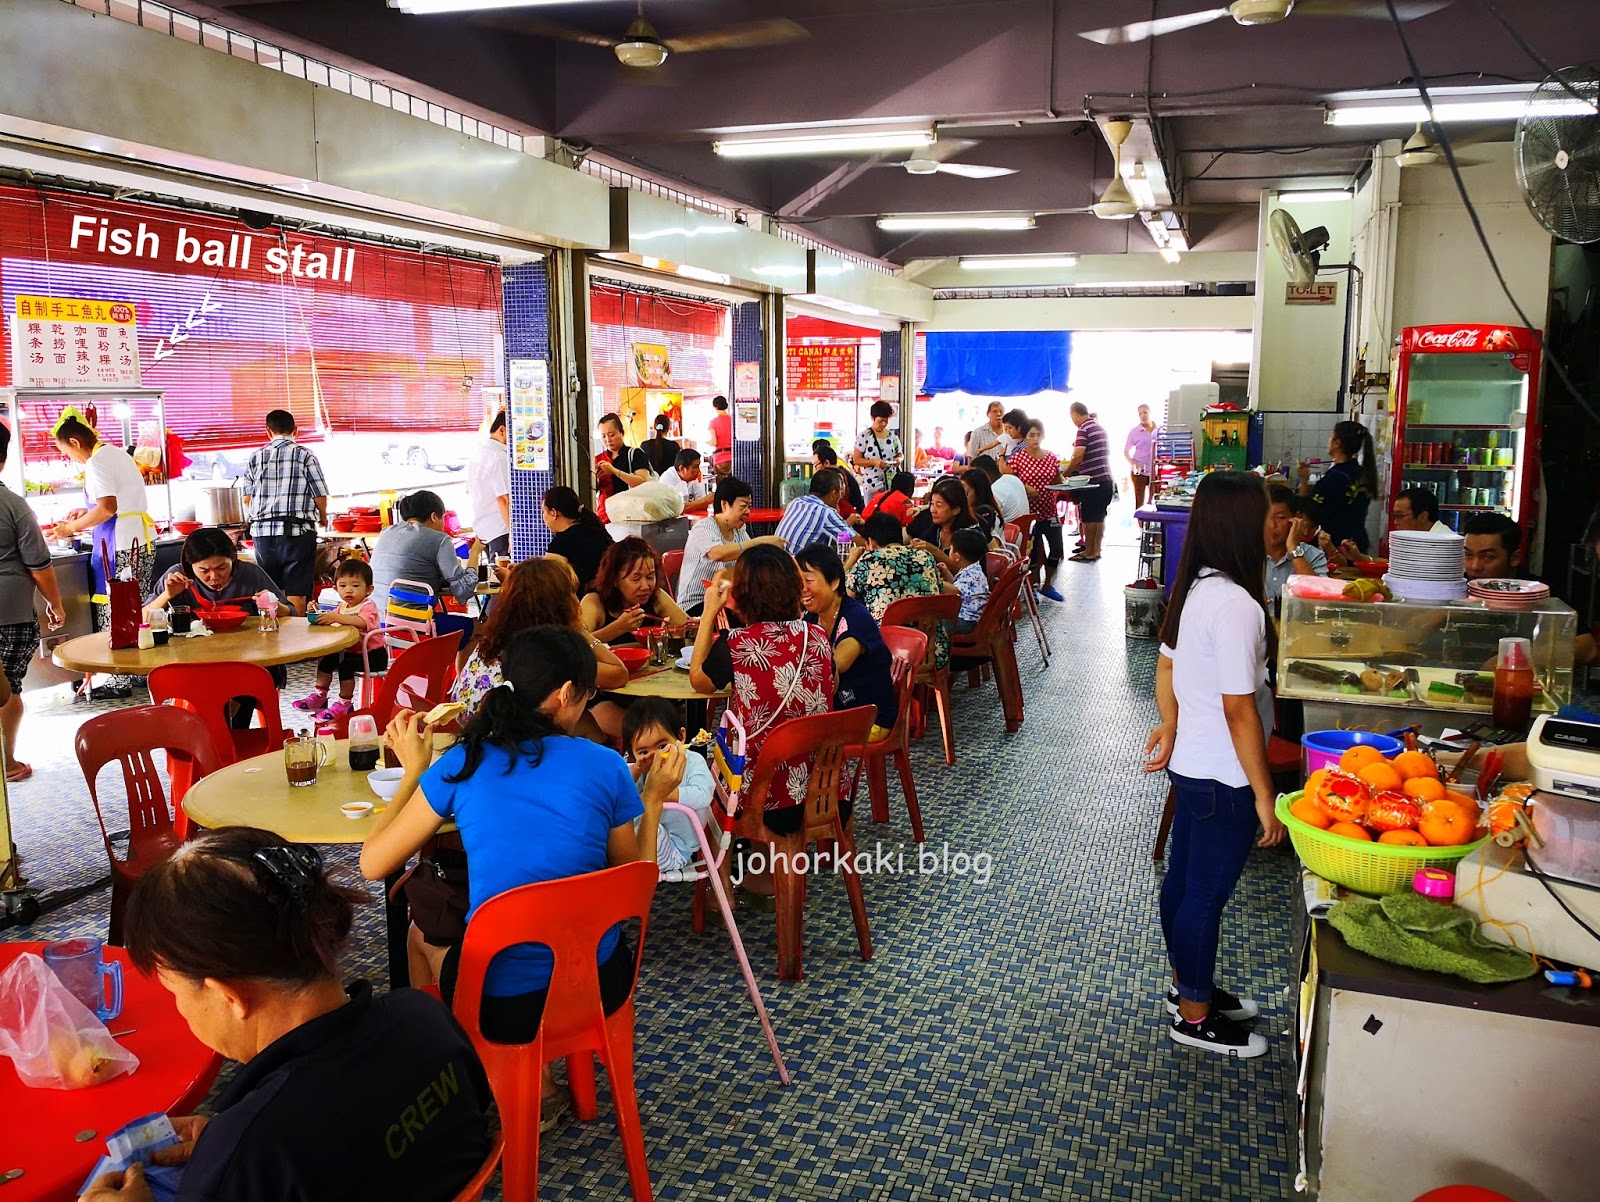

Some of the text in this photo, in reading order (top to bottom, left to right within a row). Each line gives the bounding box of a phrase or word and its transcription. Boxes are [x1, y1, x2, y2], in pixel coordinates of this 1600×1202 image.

[112, 305, 130, 314] 100%
[798, 347, 823, 356] CANAI
[1554, 733, 1588, 743] CASIO
[385, 1062, 460, 1159] CREW
